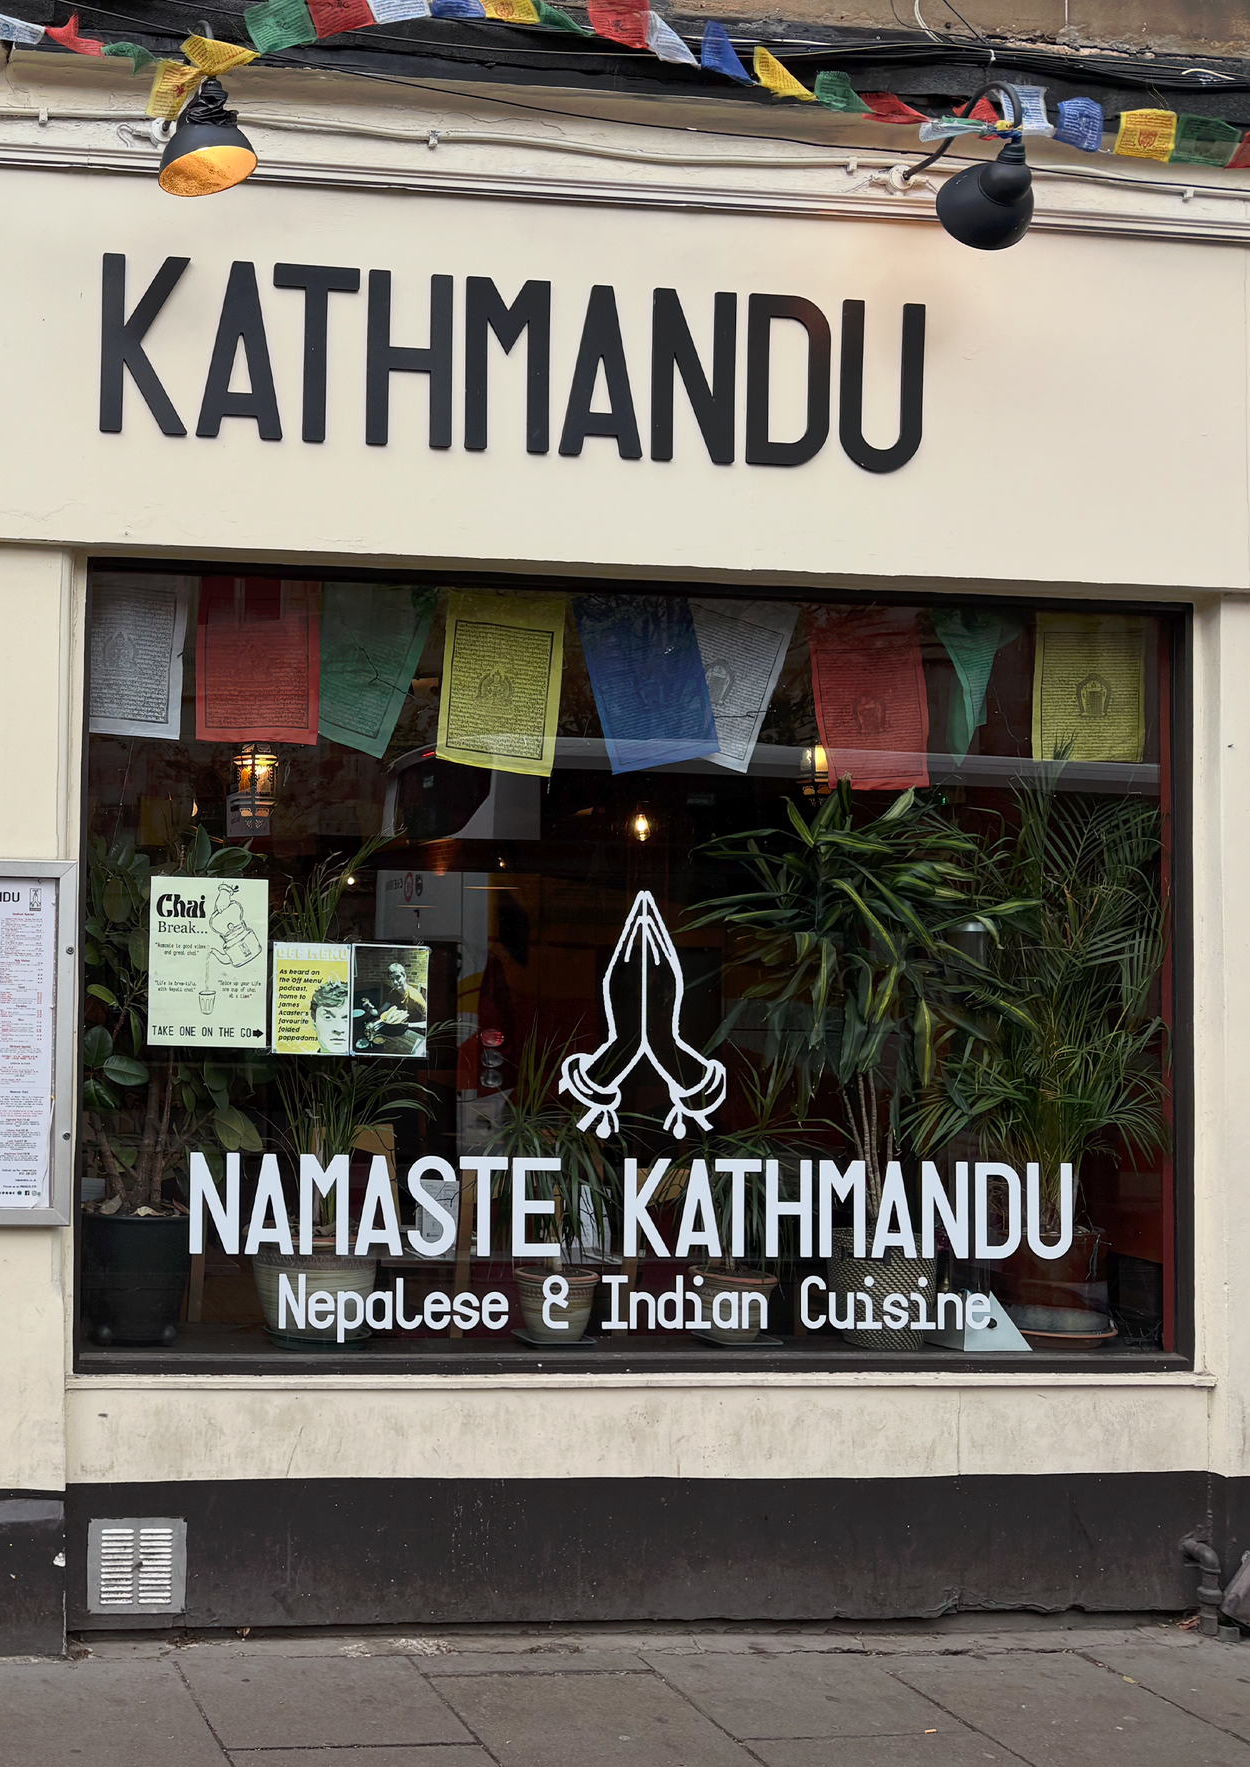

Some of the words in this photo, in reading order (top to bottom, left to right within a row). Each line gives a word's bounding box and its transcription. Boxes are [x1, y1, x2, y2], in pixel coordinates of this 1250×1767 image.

[99, 252, 927, 475] KATHMANDU
[155, 893, 207, 918] Chai
[157, 919, 208, 935] Break...
[289, 968, 310, 976] heard
[277, 1001, 300, 1009] James
[277, 1017, 310, 1025] favourite
[152, 1025, 174, 1037] TAKE
[179, 1026, 197, 1037] ONE
[201, 1026, 214, 1037] ON
[218, 1027, 235, 1038] THE
[240, 1028, 252, 1039] GO
[277, 1025, 301, 1034] folded
[277, 1034, 319, 1043] poppadoms
[188, 1152, 562, 1258] NAMASTE
[623, 1158, 1073, 1260] KATHMANDU
[278, 1273, 509, 1343] Nepalese
[542, 1274, 569, 1330] &
[601, 1275, 768, 1330] Indian
[800, 1275, 992, 1330] Cuisine
